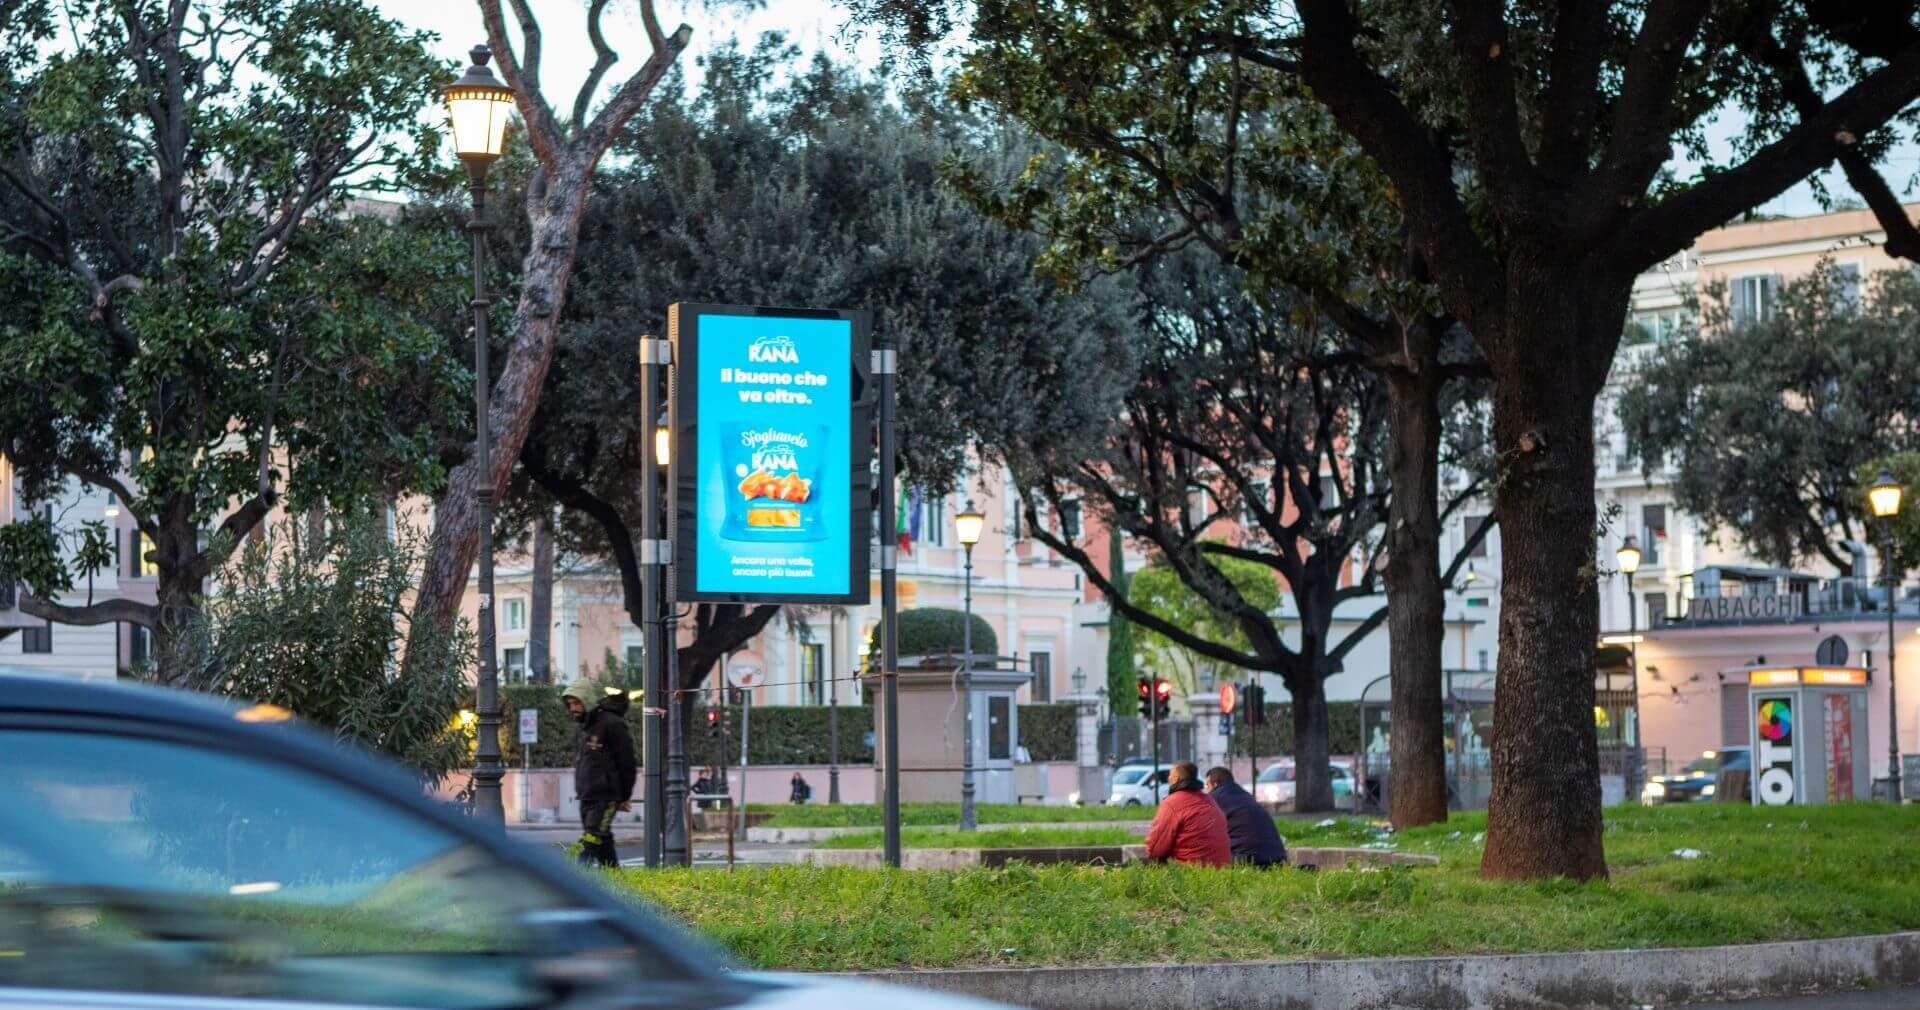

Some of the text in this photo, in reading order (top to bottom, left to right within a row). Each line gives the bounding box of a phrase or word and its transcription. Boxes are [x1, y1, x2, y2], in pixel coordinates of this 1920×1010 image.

[748, 344, 800, 363] RANA
[720, 368, 828, 386] Il buono che
[738, 388, 813, 405] va oltre.
[751, 452, 799, 471] RANA
[1687, 595, 1799, 620] TABACCHI
